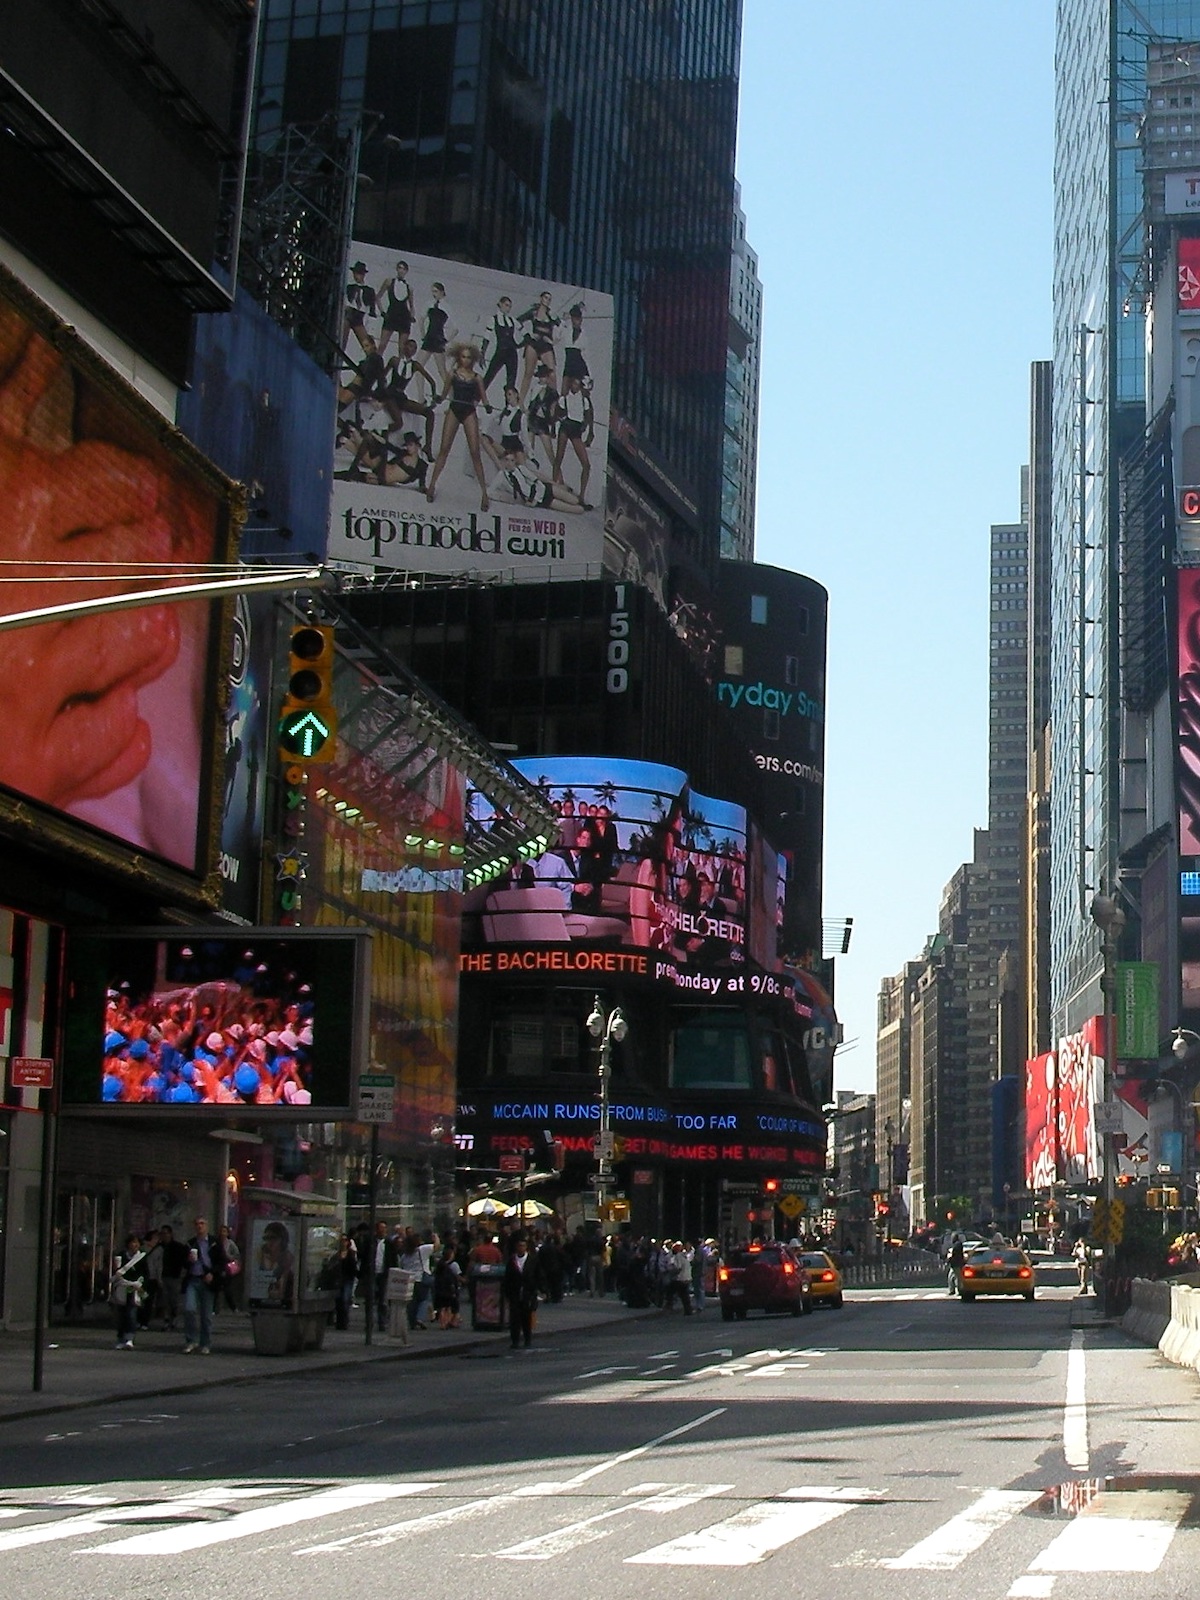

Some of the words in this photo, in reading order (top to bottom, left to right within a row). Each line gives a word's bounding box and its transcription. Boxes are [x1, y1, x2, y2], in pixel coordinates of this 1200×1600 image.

[361, 507, 426, 522] AMERICA'S
[431, 515, 462, 526] NEXT
[342, 507, 397, 558] top
[399, 513, 503, 555] model
[533, 520, 556, 536] WED
[558, 522, 566, 536] 8
[606, 585, 630, 694] 1500
[459, 955, 492, 973] THE
[497, 952, 648, 975] BACHELORETTE
[728, 975, 745, 991] at
[493, 1104, 549, 1119] MCCAIN
[555, 1103, 600, 1119] RUNS
[606, 1105, 644, 1121] FROM
[710, 1115, 737, 1129] FAR
[722, 1145, 744, 1160] HE
